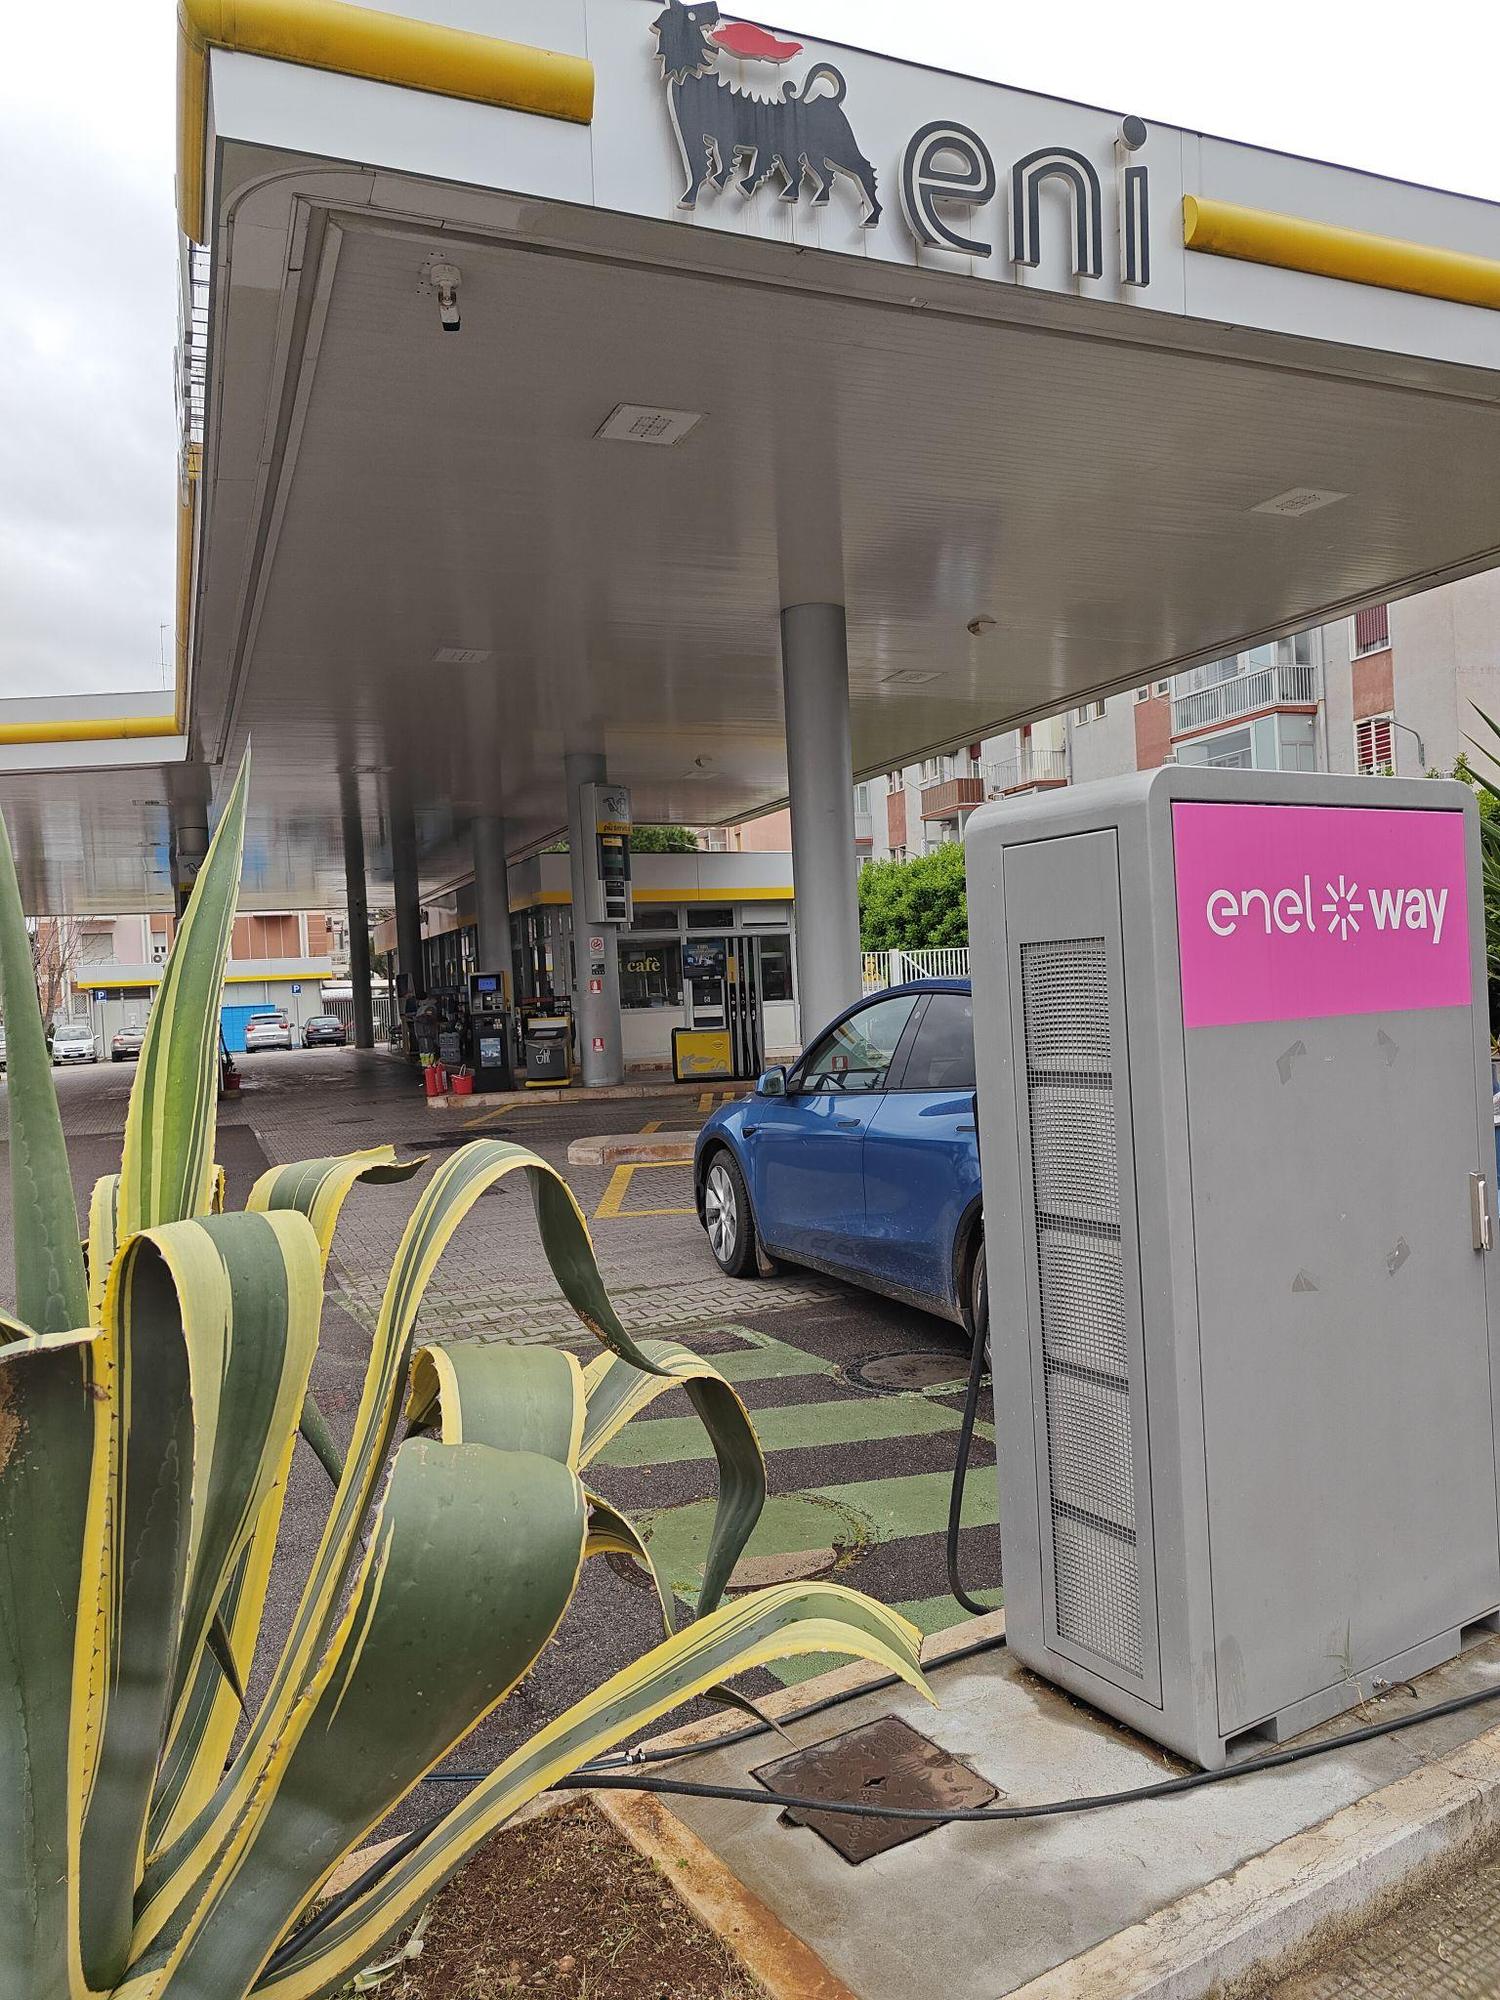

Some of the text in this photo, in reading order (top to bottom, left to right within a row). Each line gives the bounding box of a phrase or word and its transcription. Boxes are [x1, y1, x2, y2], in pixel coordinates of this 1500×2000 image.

[902, 114, 1150, 287] eni
[1206, 874, 1448, 944] enel way
